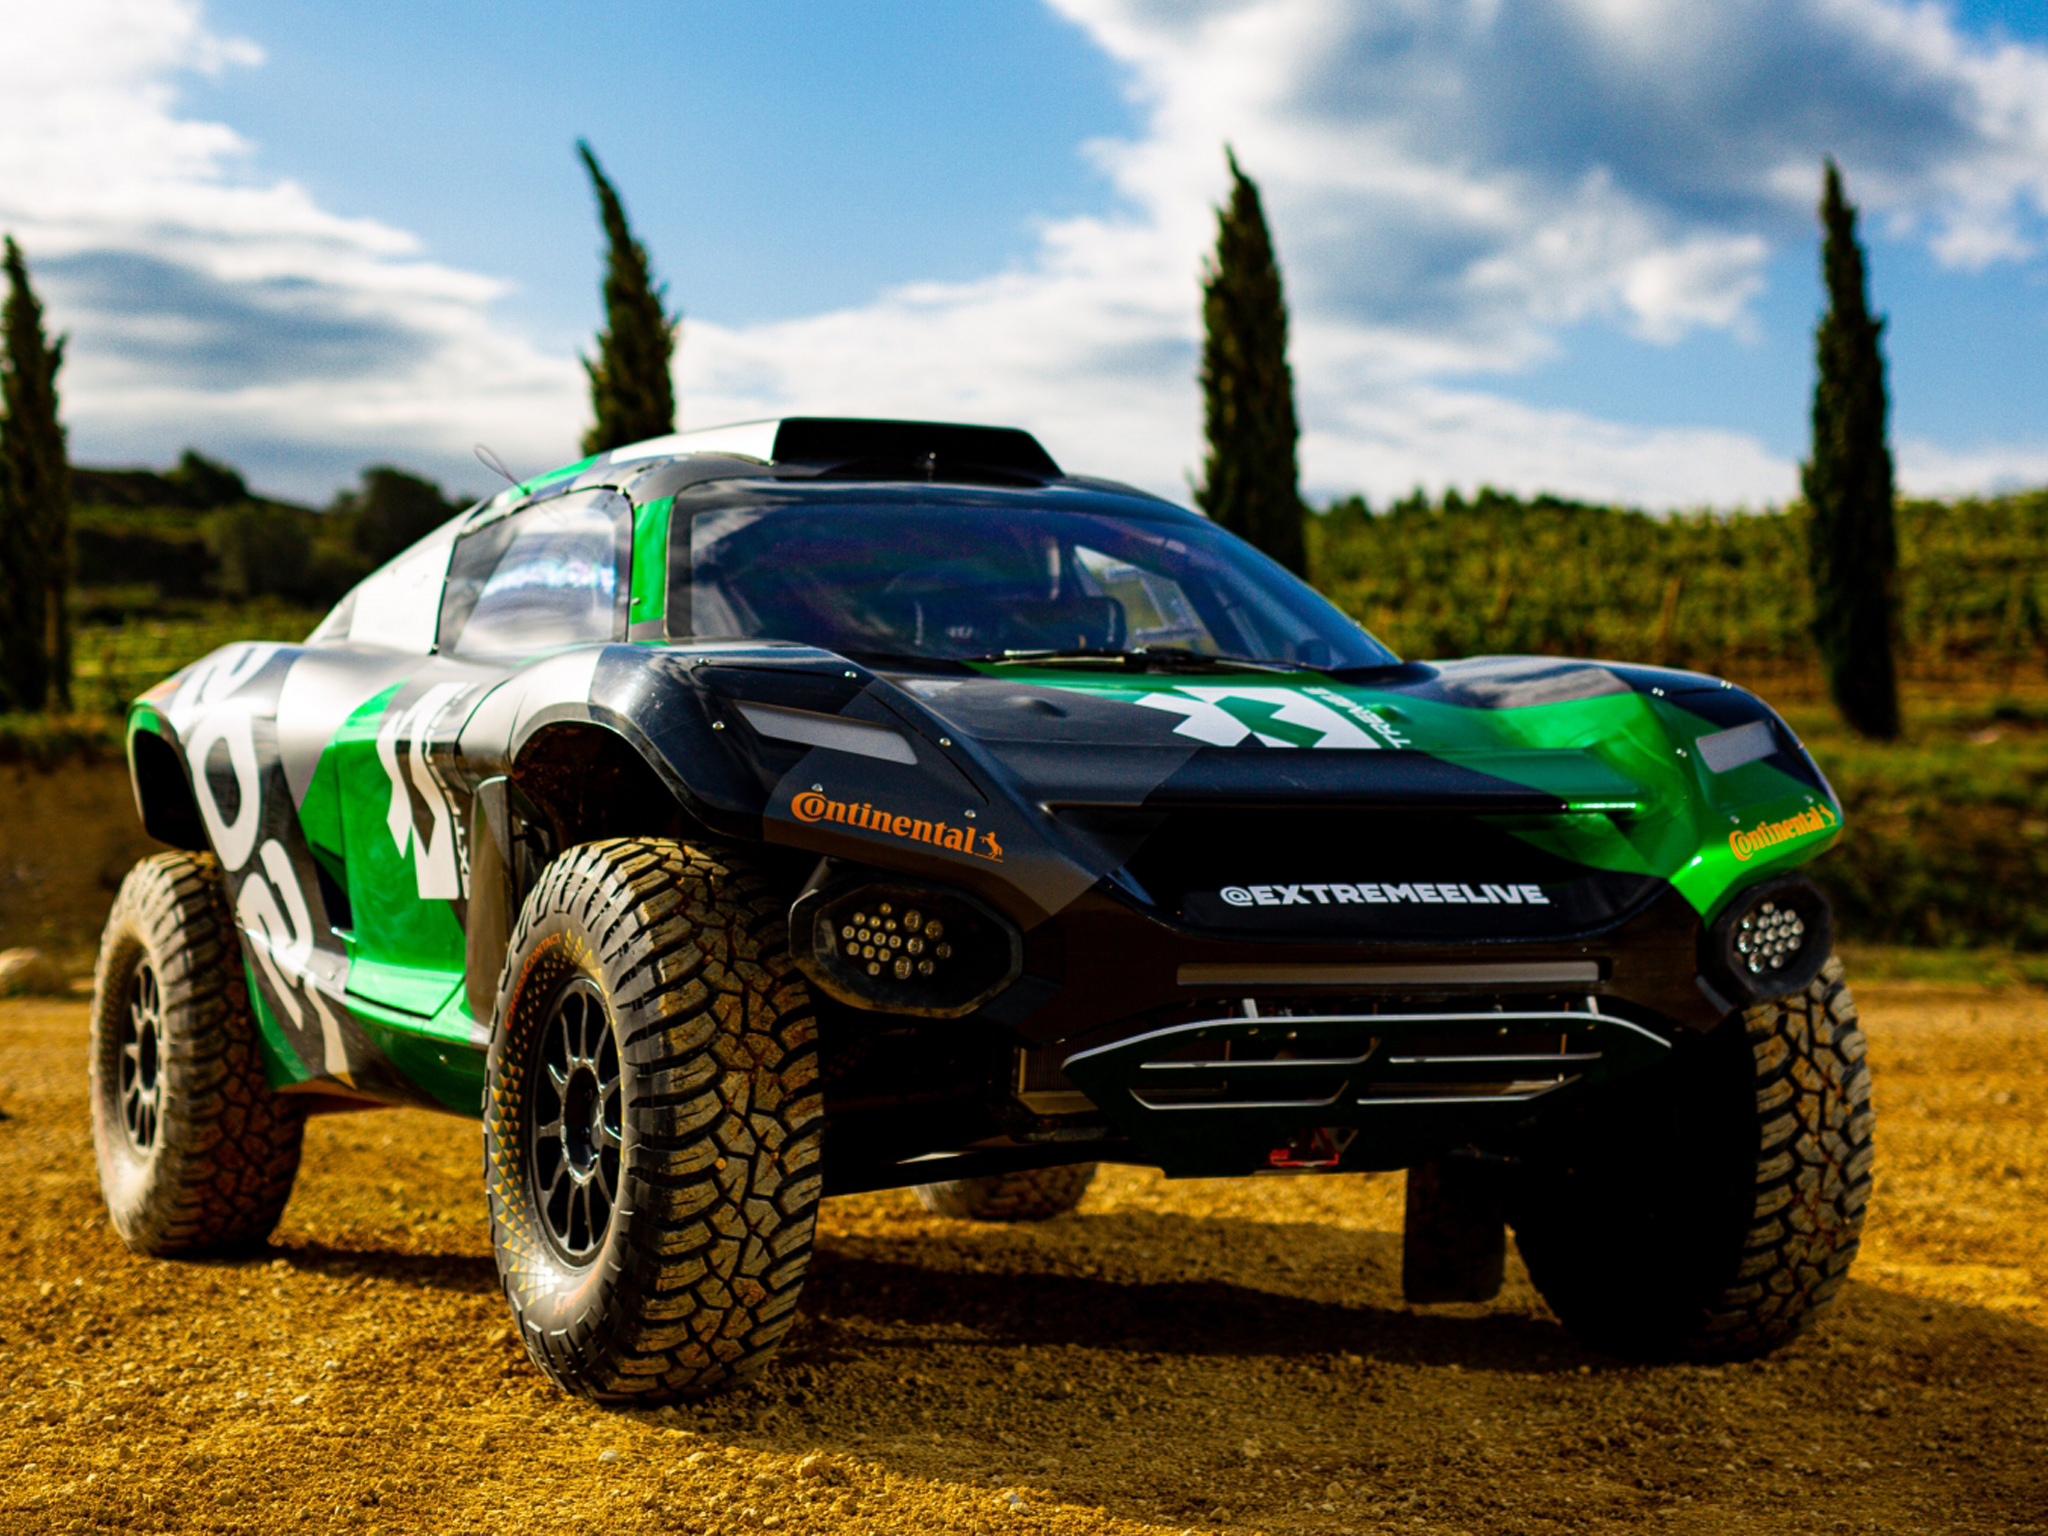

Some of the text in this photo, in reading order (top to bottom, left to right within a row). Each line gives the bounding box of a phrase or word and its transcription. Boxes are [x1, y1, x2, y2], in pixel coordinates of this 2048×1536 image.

[791, 791, 976, 854] Continental
[1728, 806, 1825, 862] Continental
[1219, 883, 1551, 907] @EXTREMEELIVE
